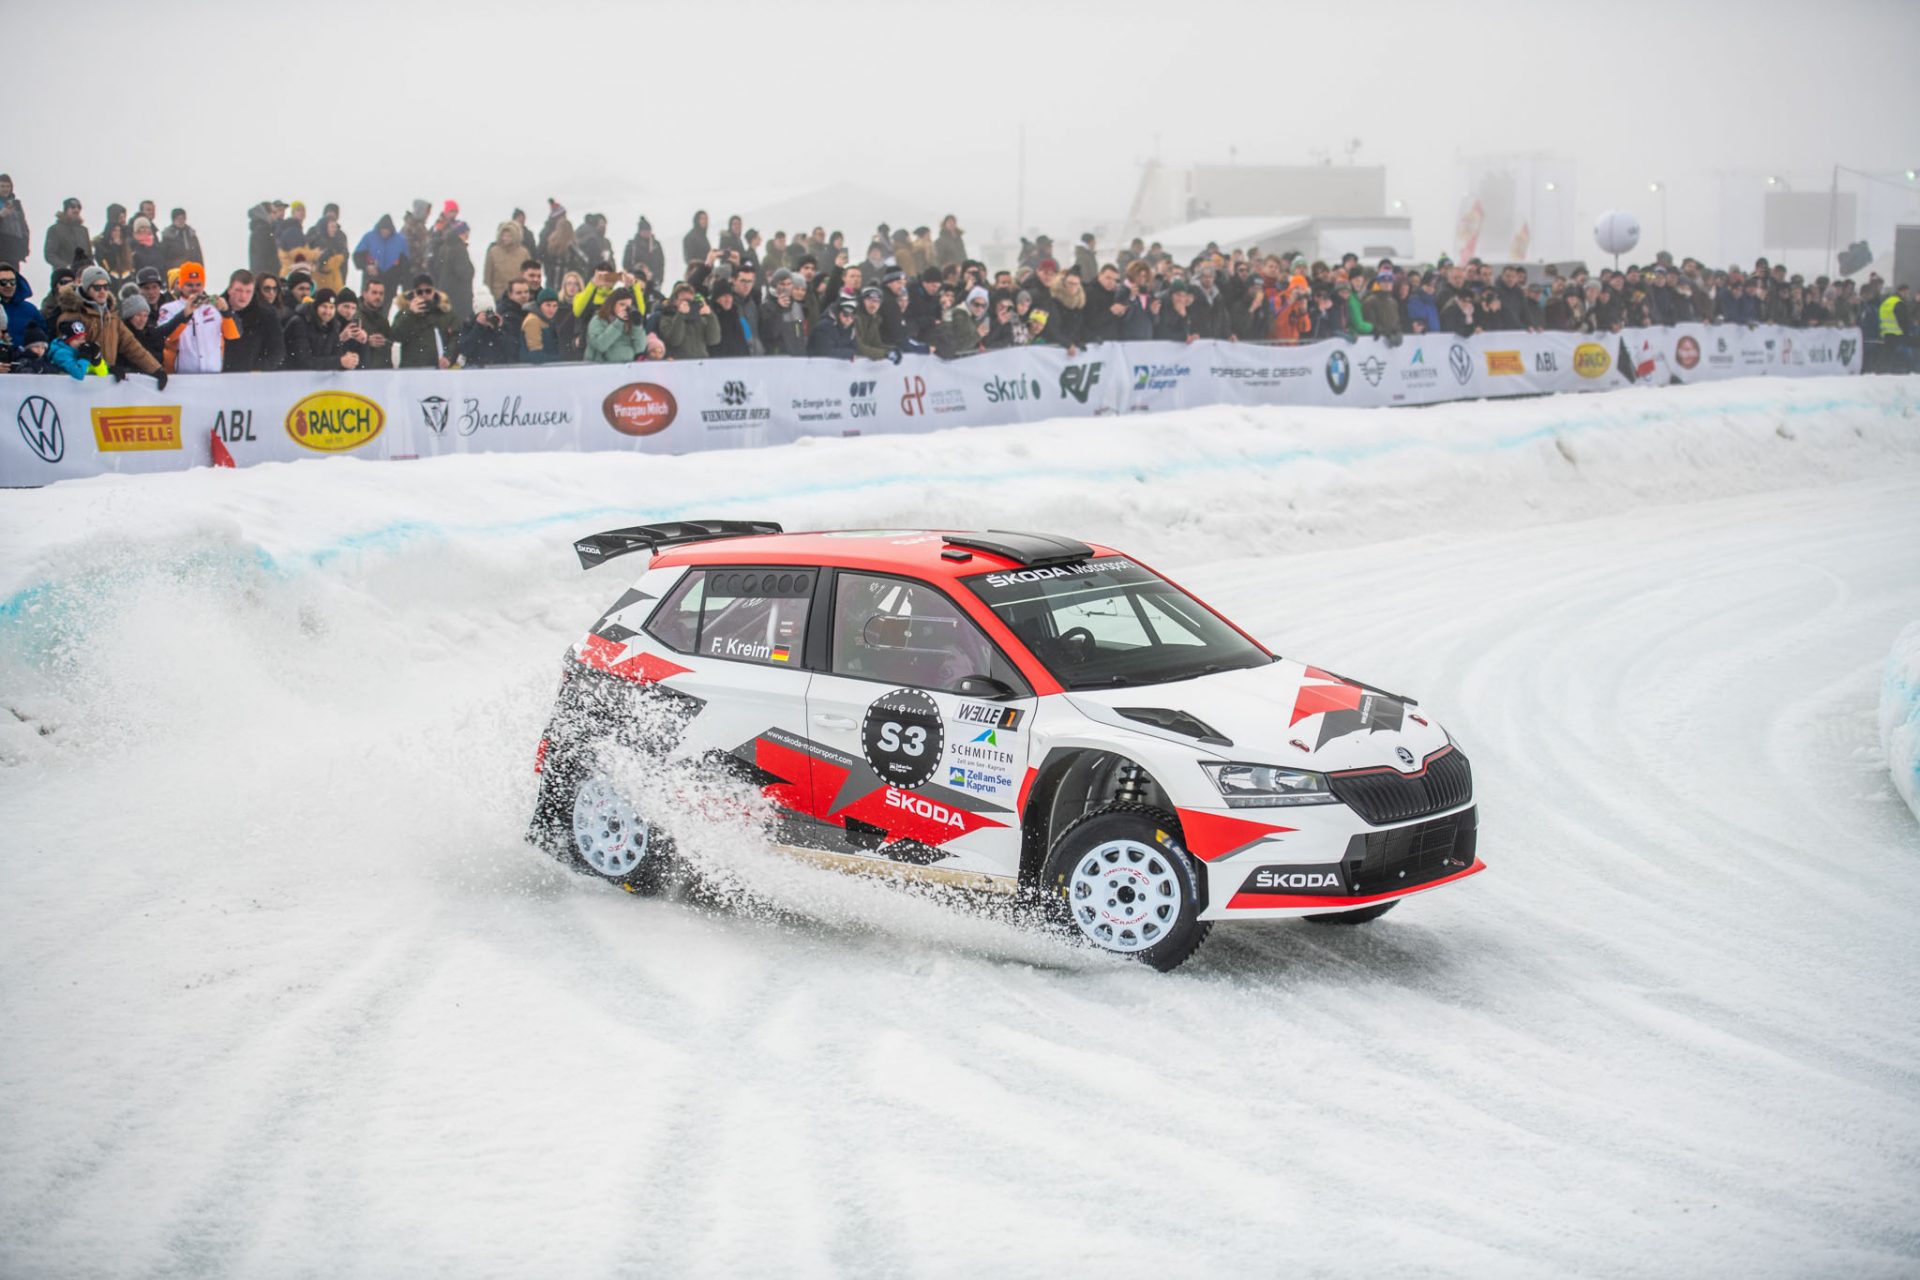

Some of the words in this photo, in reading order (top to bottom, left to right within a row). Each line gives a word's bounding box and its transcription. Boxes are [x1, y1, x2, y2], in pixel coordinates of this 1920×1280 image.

[1536, 352, 1559, 372] ABL
[1210, 367, 1269, 378] PORSCHE
[1273, 366, 1313, 378] DESIGN
[458, 395, 574, 437] Backhausen
[613, 404, 647, 420] Pinzgau
[647, 403, 668, 416] Milch
[701, 408, 748, 423] WIENINGER
[850, 402, 877, 418] OMV
[309, 409, 371, 435] RAUCH
[577, 543, 601, 555] ŠKODA
[986, 566, 1071, 588] ŠKODA
[1067, 560, 1137, 576] Motorsport
[711, 637, 722, 653] F.
[726, 638, 770, 659] Kreim
[906, 707, 927, 716] RACE
[877, 721, 927, 757] S3
[951, 743, 1014, 764] SCHMITTEN
[966, 769, 982, 782] Zell
[981, 773, 996, 785] am
[996, 775, 1012, 787] See
[966, 780, 996, 793] Kaprun
[885, 786, 966, 831] ŠKODA
[1256, 870, 1340, 889] ŠKODA
[1119, 912, 1149, 926] RACING
